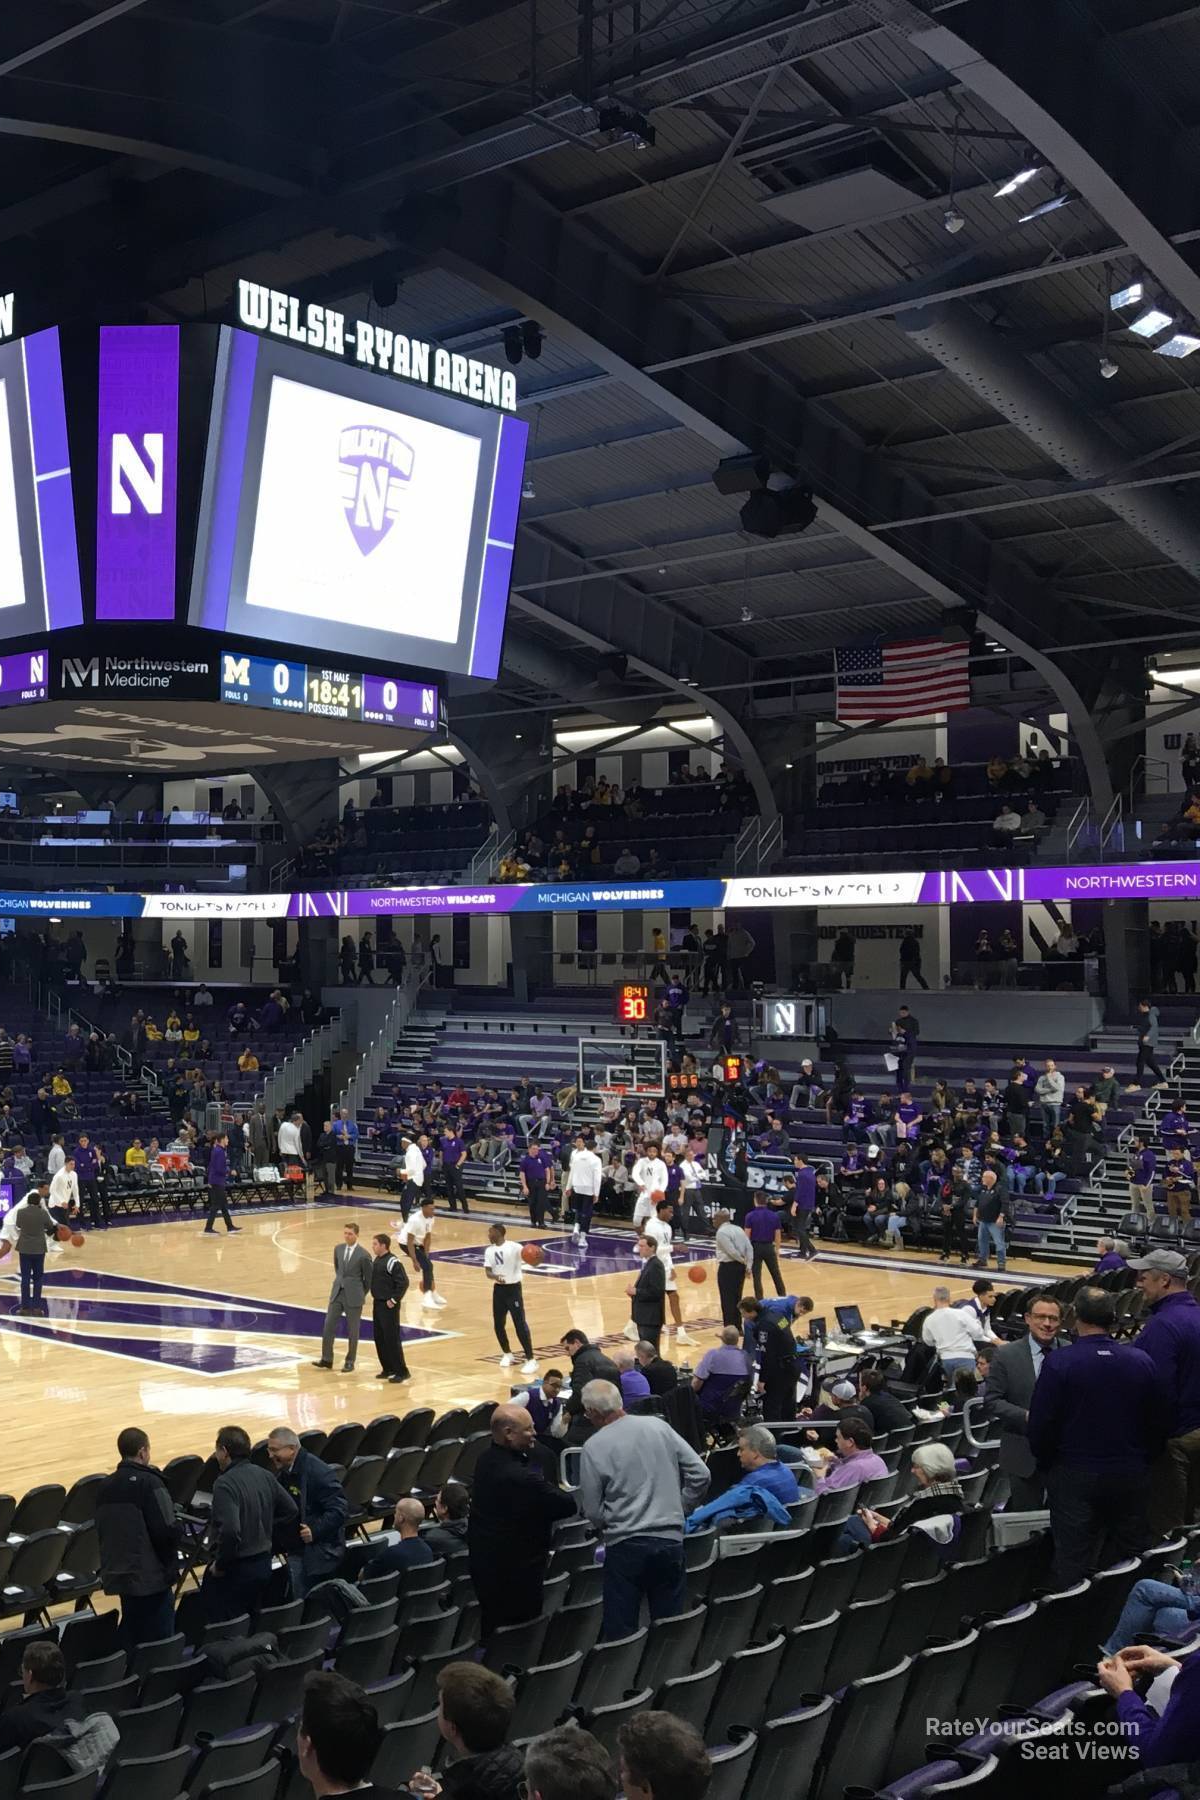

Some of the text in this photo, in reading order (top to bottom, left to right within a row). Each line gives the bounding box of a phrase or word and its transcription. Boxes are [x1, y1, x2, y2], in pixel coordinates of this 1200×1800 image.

[239, 278, 517, 412] WELSH-RYAN ARENA
[111, 433, 164, 514] N
[30, 655, 44, 684] N
[105, 656, 209, 673] Northwestern
[224, 655, 250, 686] M
[104, 673, 170, 687] Medicine
[273, 663, 290, 694] 0
[333, 671, 350, 684] HALF
[225, 690, 241, 700] FOULS
[309, 678, 361, 708] 18:41
[383, 681, 398, 710] 0
[422, 688, 434, 714] N
[308, 702, 348, 718] POSSESSION
[1065, 873, 1197, 889] NORTHWESTERN
[30, 899, 91, 910] WOLVERINES
[370, 894, 496, 908] NORTHWESTERN WILDCATS
[538, 889, 664, 903] MICHIGAN WOLVERINES
[624, 998, 646, 1019] 30
[775, 1003, 795, 1033] N
[707, 1152, 718, 1169] N
